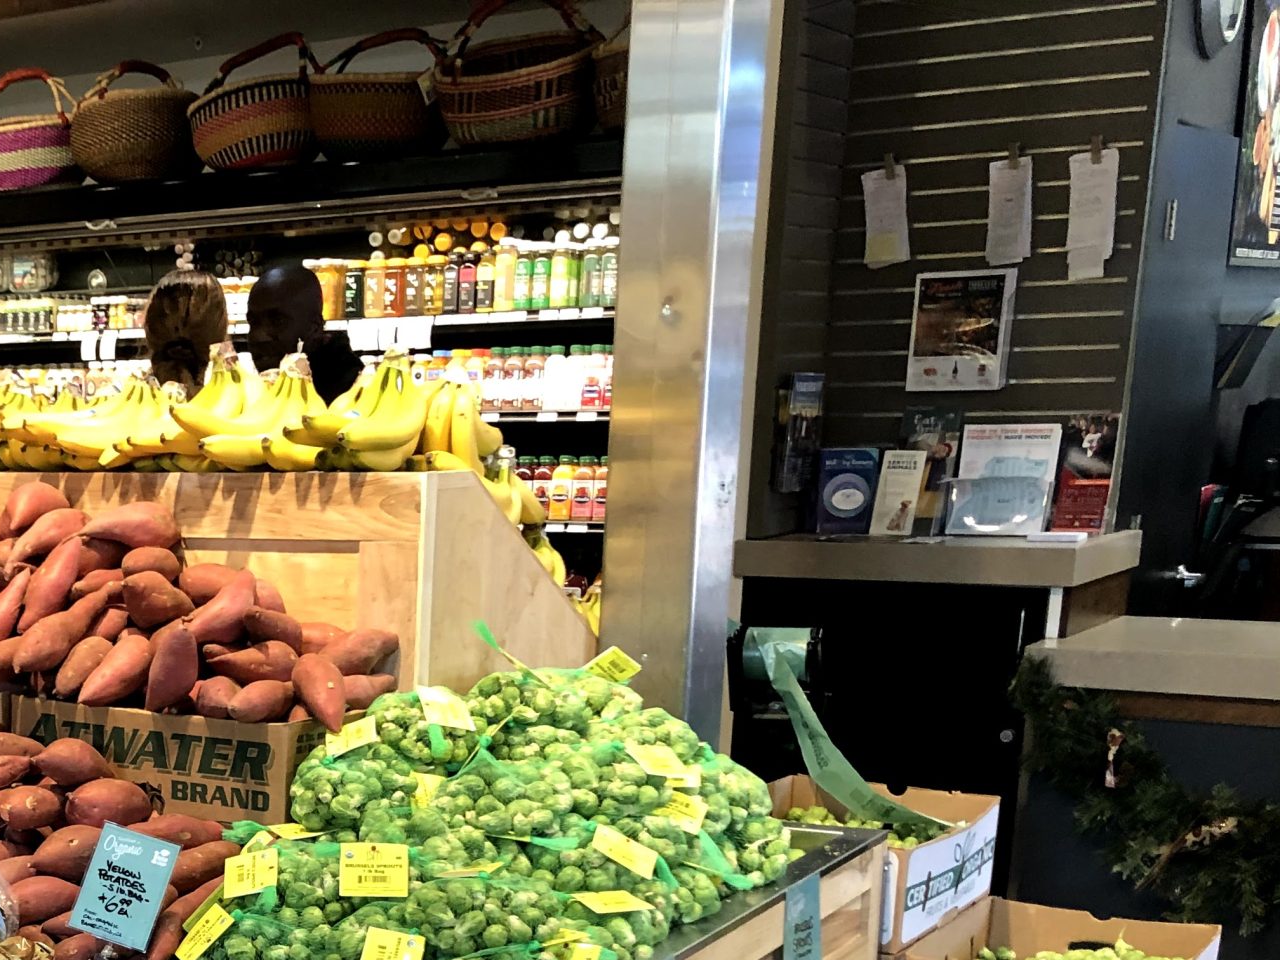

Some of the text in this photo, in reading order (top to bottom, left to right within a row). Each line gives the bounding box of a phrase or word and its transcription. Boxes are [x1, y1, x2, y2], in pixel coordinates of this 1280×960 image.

[24, 712, 272, 785] ATWATER
[171, 780, 272, 813] BRAND
[104, 834, 143, 860] Organic
[98, 868, 146, 894] POTATOES
